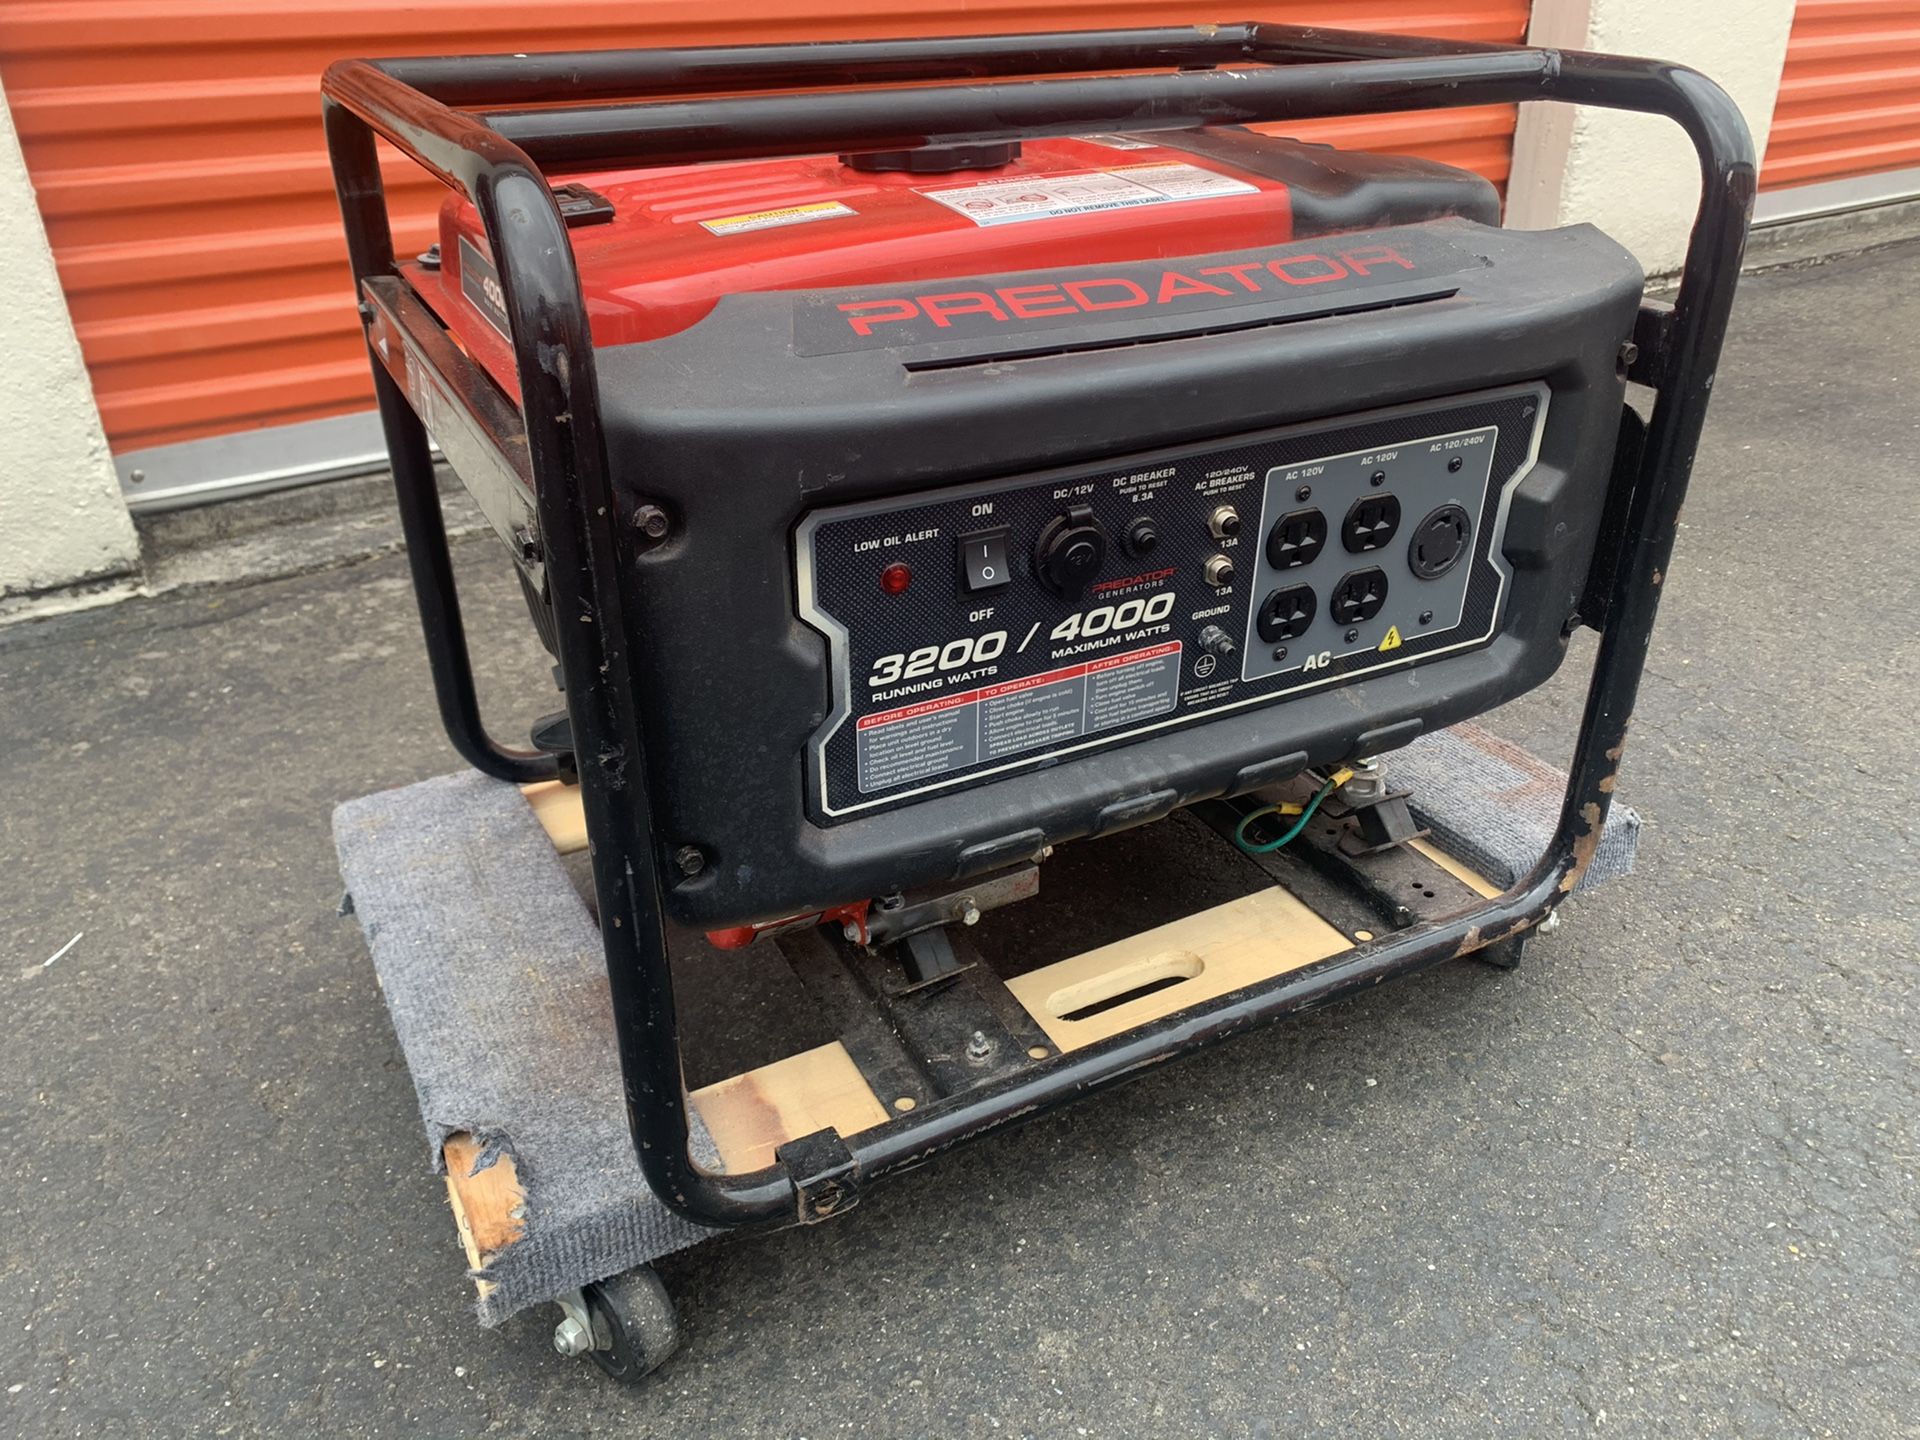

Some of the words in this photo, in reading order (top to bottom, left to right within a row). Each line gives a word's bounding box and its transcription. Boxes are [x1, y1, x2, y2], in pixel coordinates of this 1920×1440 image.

[1065, 206, 1082, 214] NOT
[1083, 202, 1118, 212] REMOVE
[1120, 199, 1139, 208] THIS
[1139, 195, 1166, 205] LABEL
[837, 246, 1416, 336] PREDATOR
[1429, 443, 1442, 453] AC
[1444, 434, 1486, 450] 120/240V
[1361, 455, 1373, 466] AC
[1375, 451, 1398, 464] 120V
[1113, 477, 1127, 488] DC
[1130, 467, 1176, 485] BREAKER
[1194, 481, 1208, 492] AC
[1209, 471, 1256, 489] BREAKERS
[1205, 465, 1249, 480] 120/240V
[1285, 470, 1298, 481] AC
[1301, 465, 1325, 478] 120V
[1053, 483, 1095, 500] DC/12V
[1119, 485, 1137, 495] PUSH
[1138, 483, 1147, 492] TO
[1147, 480, 1168, 490] RESET
[1132, 491, 1154, 503] 8.3A
[1203, 487, 1219, 497] PUSH
[1219, 486, 1227, 494] TO
[1228, 482, 1246, 493] RESET
[971, 502, 993, 517] ON
[854, 539, 880, 553] LOW
[883, 535, 902, 548] OIL
[904, 528, 940, 543] ALERT
[1220, 537, 1239, 549] 13A
[1092, 566, 1178, 593] PREDATOR
[1098, 579, 1165, 601] GENERATORS
[1214, 586, 1233, 597] 13A
[968, 607, 995, 623] OFF
[1191, 604, 1230, 620] GROUND
[868, 630, 1008, 687] 3200
[1016, 622, 1041, 653] /
[1050, 591, 1176, 642] 4000
[1051, 635, 1122, 660] MAXIMUM
[1125, 624, 1170, 642] WATTS
[1092, 658, 1120, 671] AFTER
[1123, 644, 1174, 663] OPERATING:
[1303, 650, 1332, 673] AC
[872, 678, 943, 703] RUNNING
[947, 665, 998, 687] WATTS
[985, 689, 998, 698] TO
[1001, 676, 1045, 694] OPERATE:
[864, 711, 903, 727] BEFORE
[907, 696, 964, 716] OPERATING:
